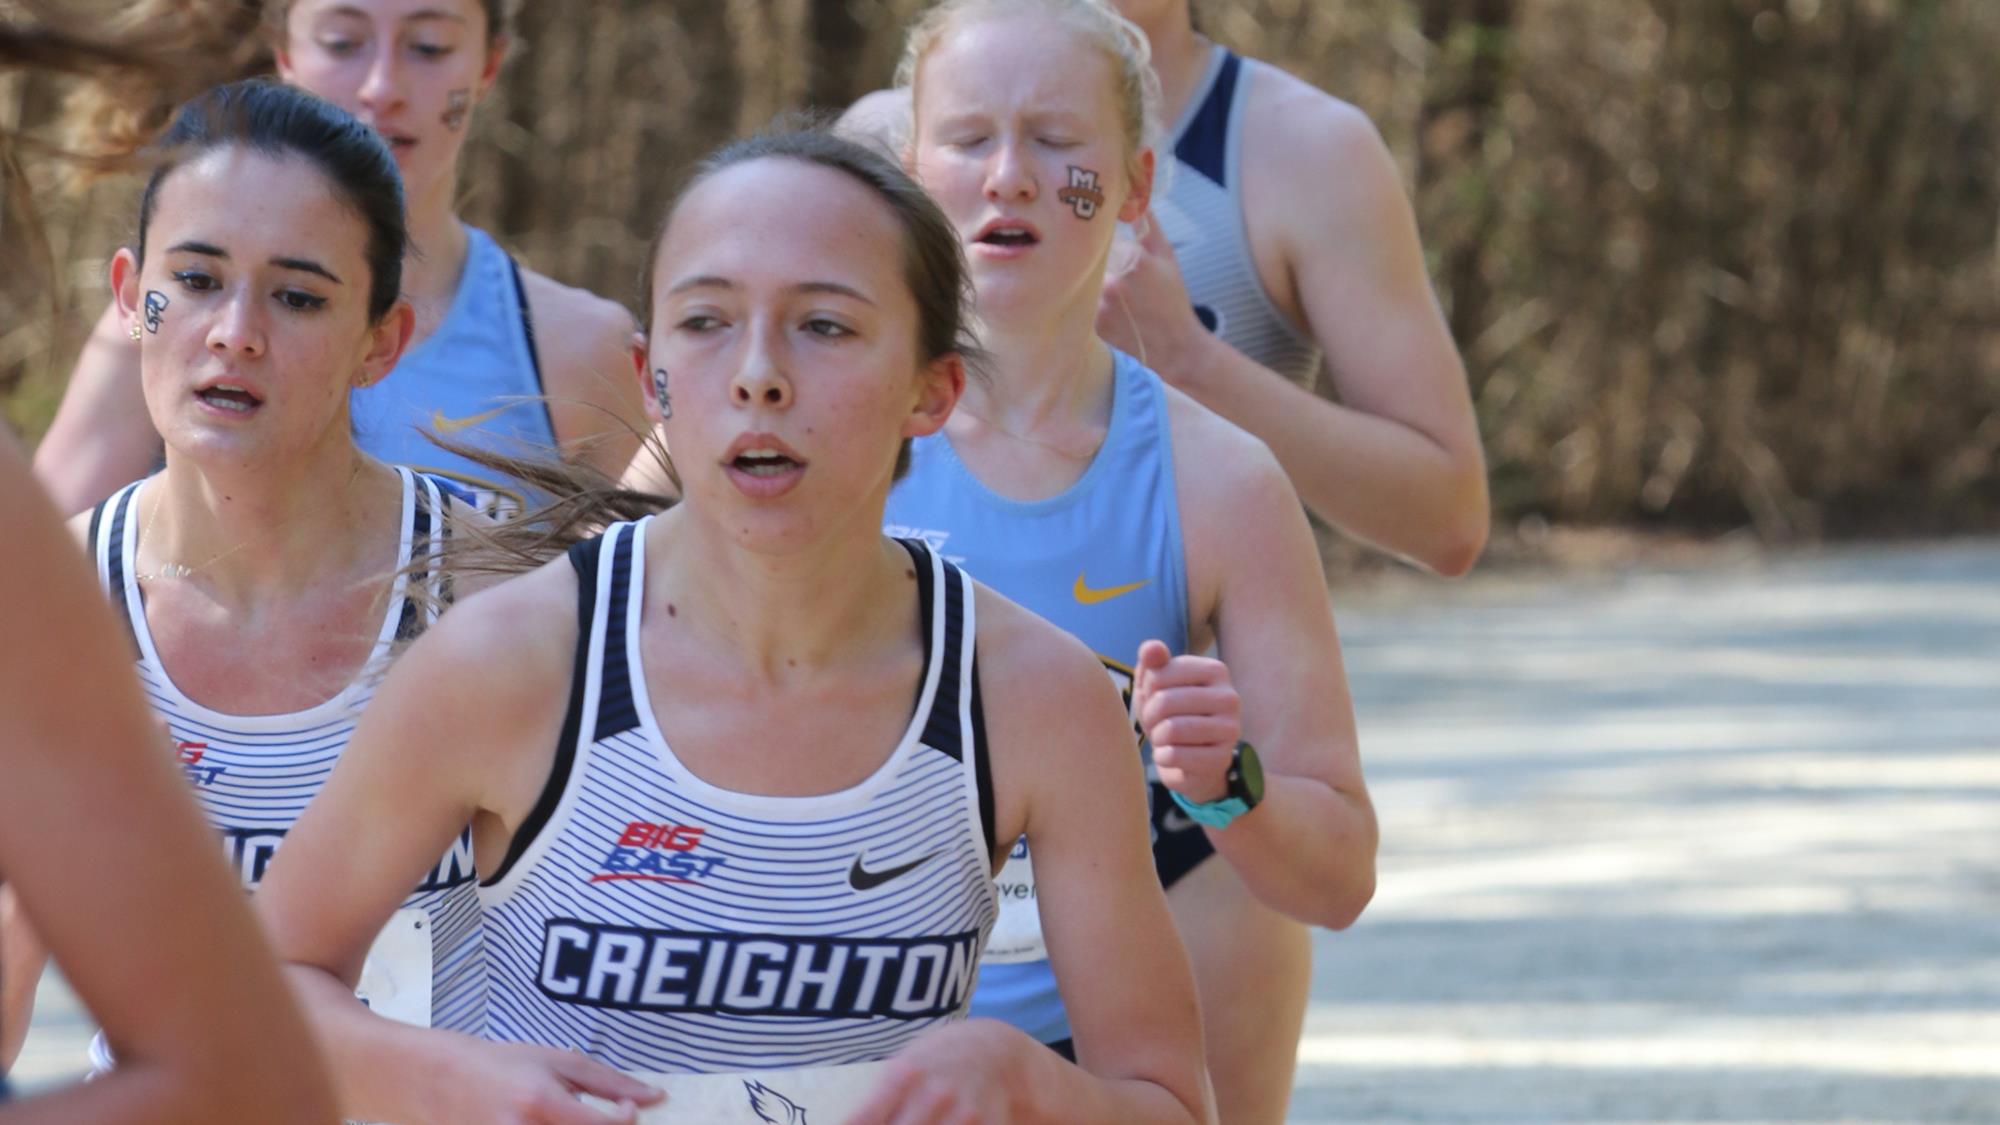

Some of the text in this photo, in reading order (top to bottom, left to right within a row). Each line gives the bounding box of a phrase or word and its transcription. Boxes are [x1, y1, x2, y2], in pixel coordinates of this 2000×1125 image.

[618, 821, 705, 851] BIG
[601, 847, 727, 878] EAST
[540, 921, 979, 1014] CREIGHTON
